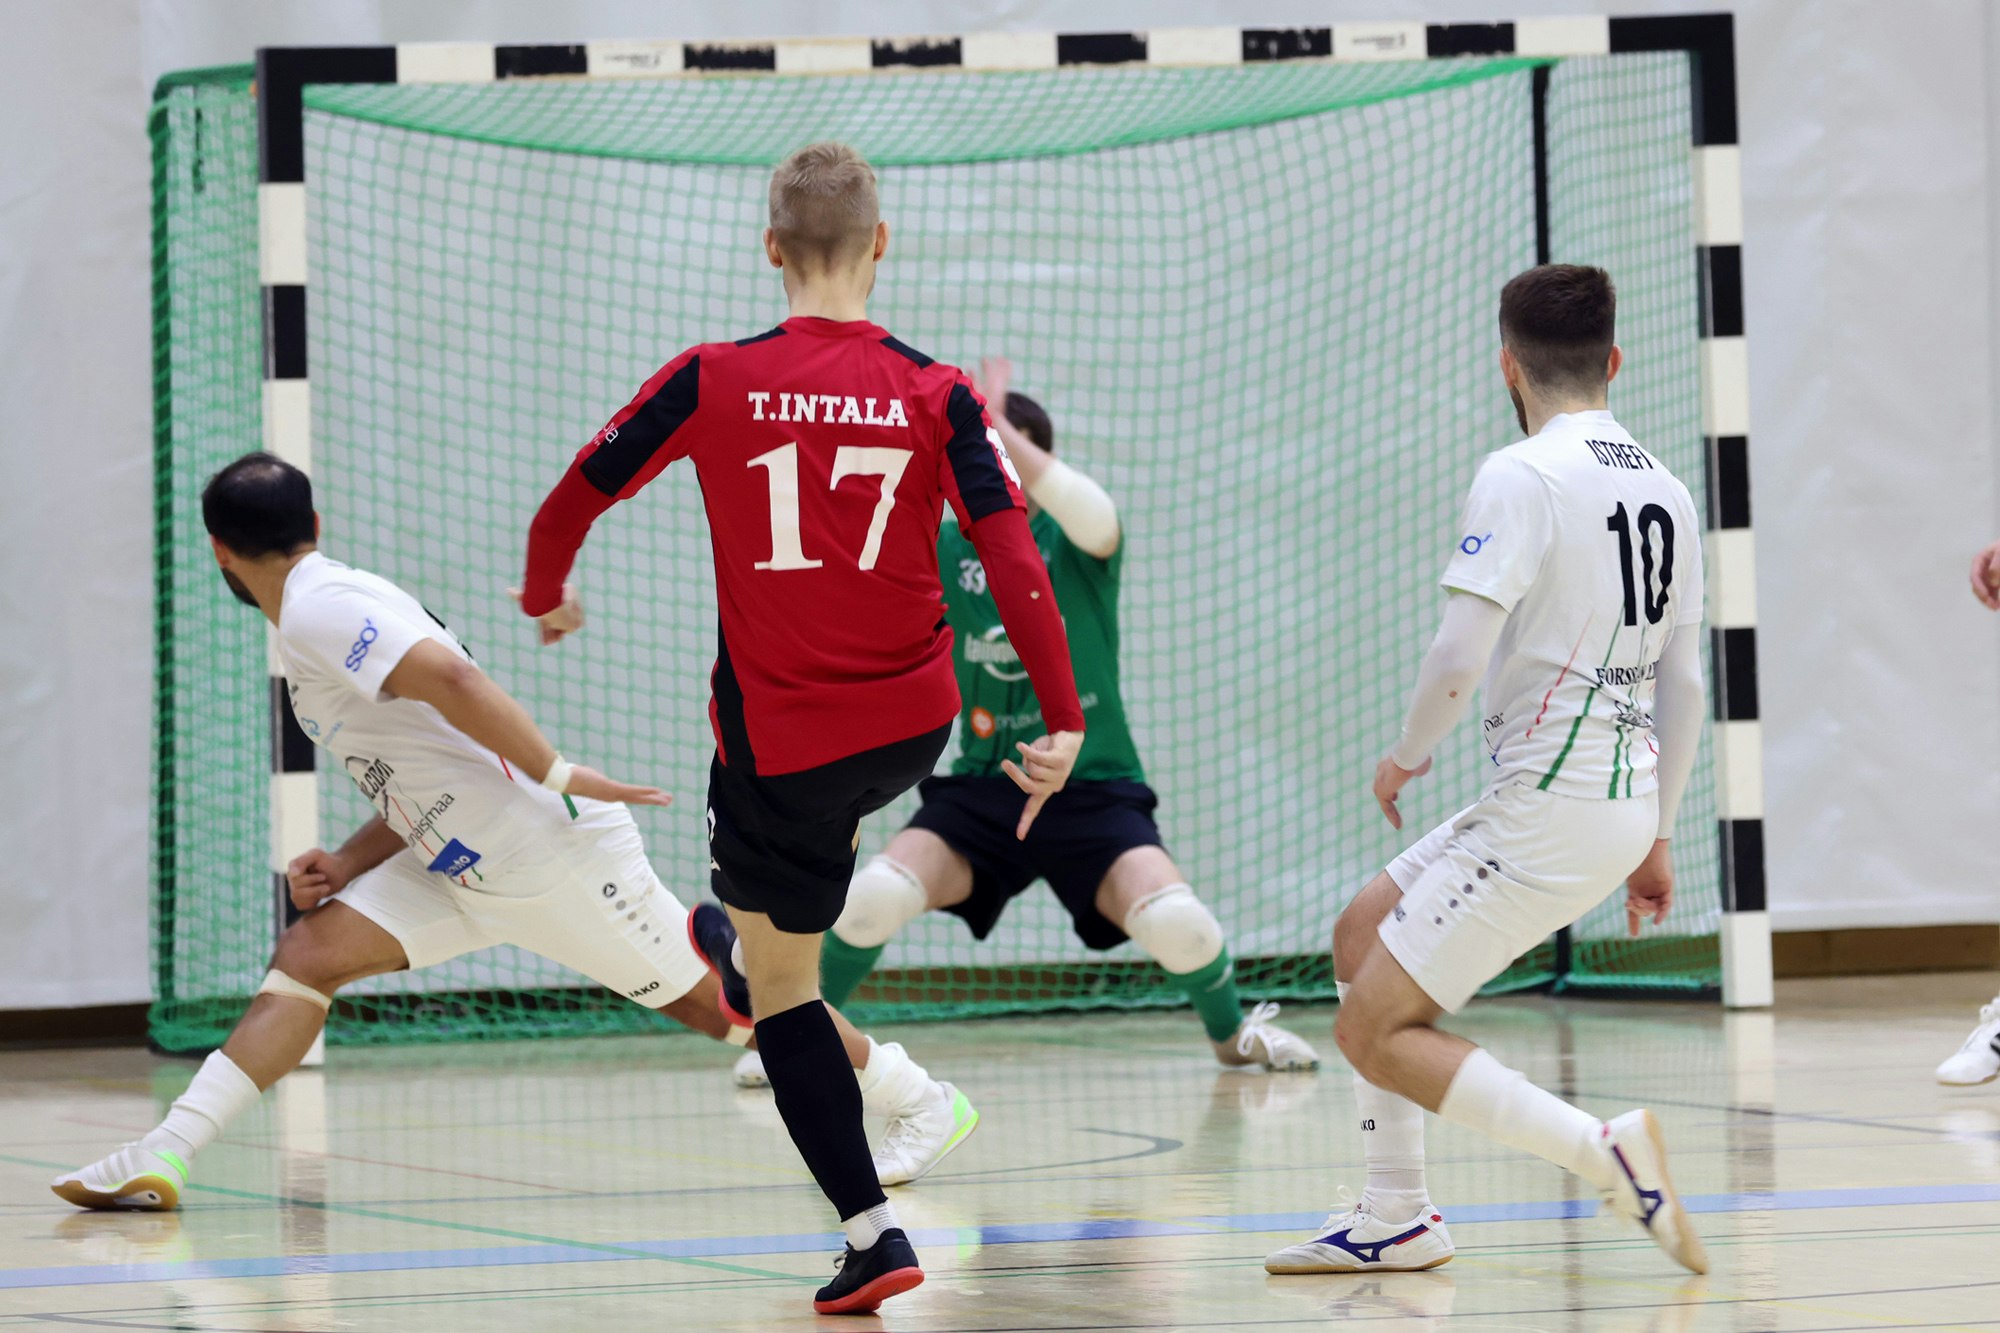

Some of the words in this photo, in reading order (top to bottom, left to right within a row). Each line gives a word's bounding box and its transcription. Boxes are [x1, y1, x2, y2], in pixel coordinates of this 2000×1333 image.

[748, 391, 909, 428] T.INTALA
[1585, 439, 1654, 470] ISTREFI
[747, 441, 915, 571] 17
[1607, 501, 1675, 627] 10
